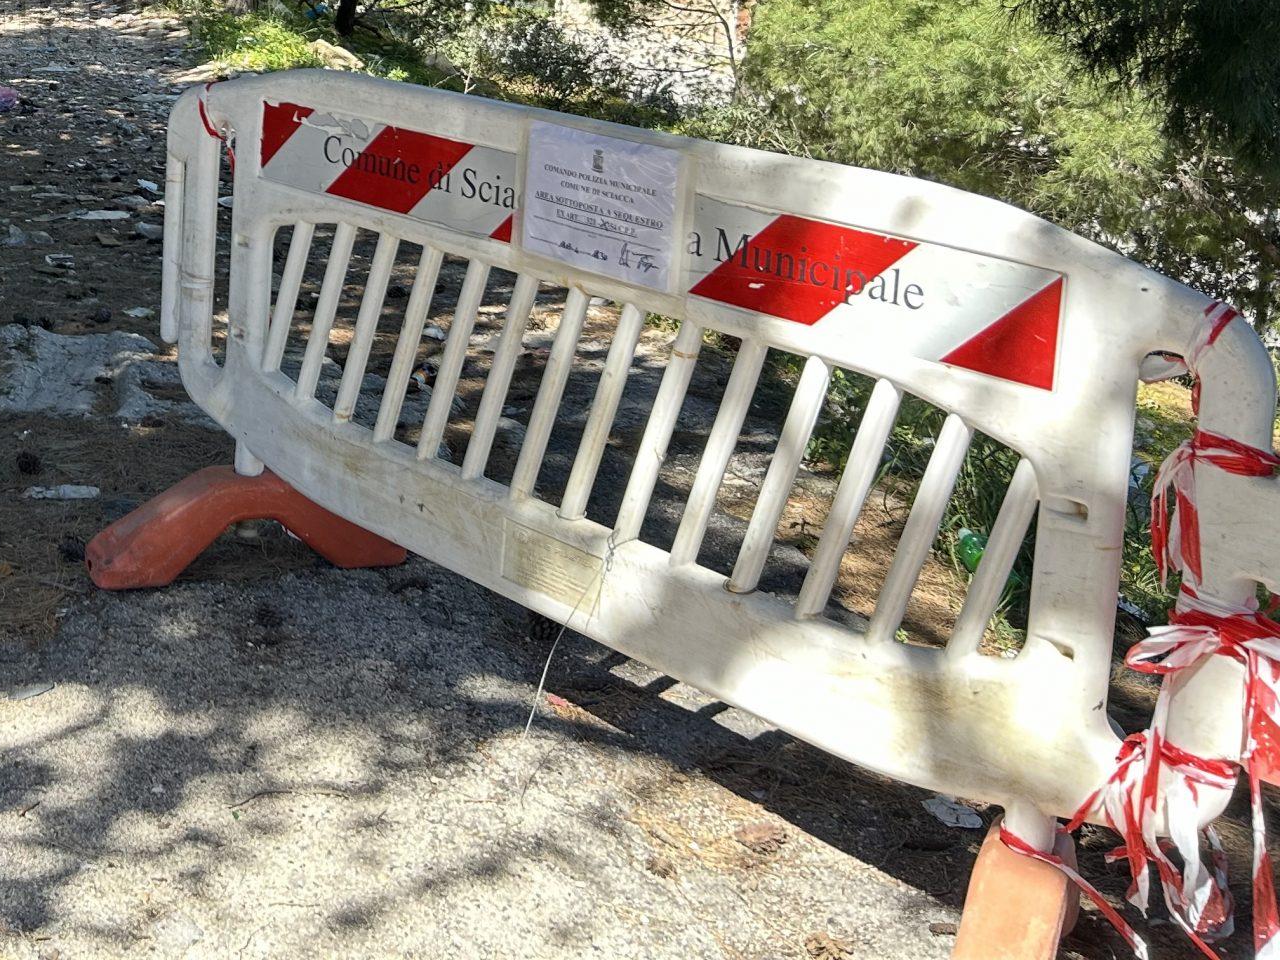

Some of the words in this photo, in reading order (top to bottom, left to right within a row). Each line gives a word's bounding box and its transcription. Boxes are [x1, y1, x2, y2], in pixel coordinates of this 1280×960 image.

[323, 135, 420, 184] Comune
[428, 161, 451, 193] di
[460, 167, 522, 210] Scia
[544, 163, 578, 179] COMANDO
[578, 172, 608, 185] POLIZIA
[609, 179, 657, 197] MUNICIPALE
[560, 180, 590, 194] COMUNE
[592, 187, 600, 195] DI
[600, 190, 635, 204] SCIACCA
[535, 190, 554, 202] AREA
[555, 196, 604, 215] SOTTOPOSTA
[612, 209, 664, 229] SEQUESTRO
[713, 226, 925, 310] Municipale
